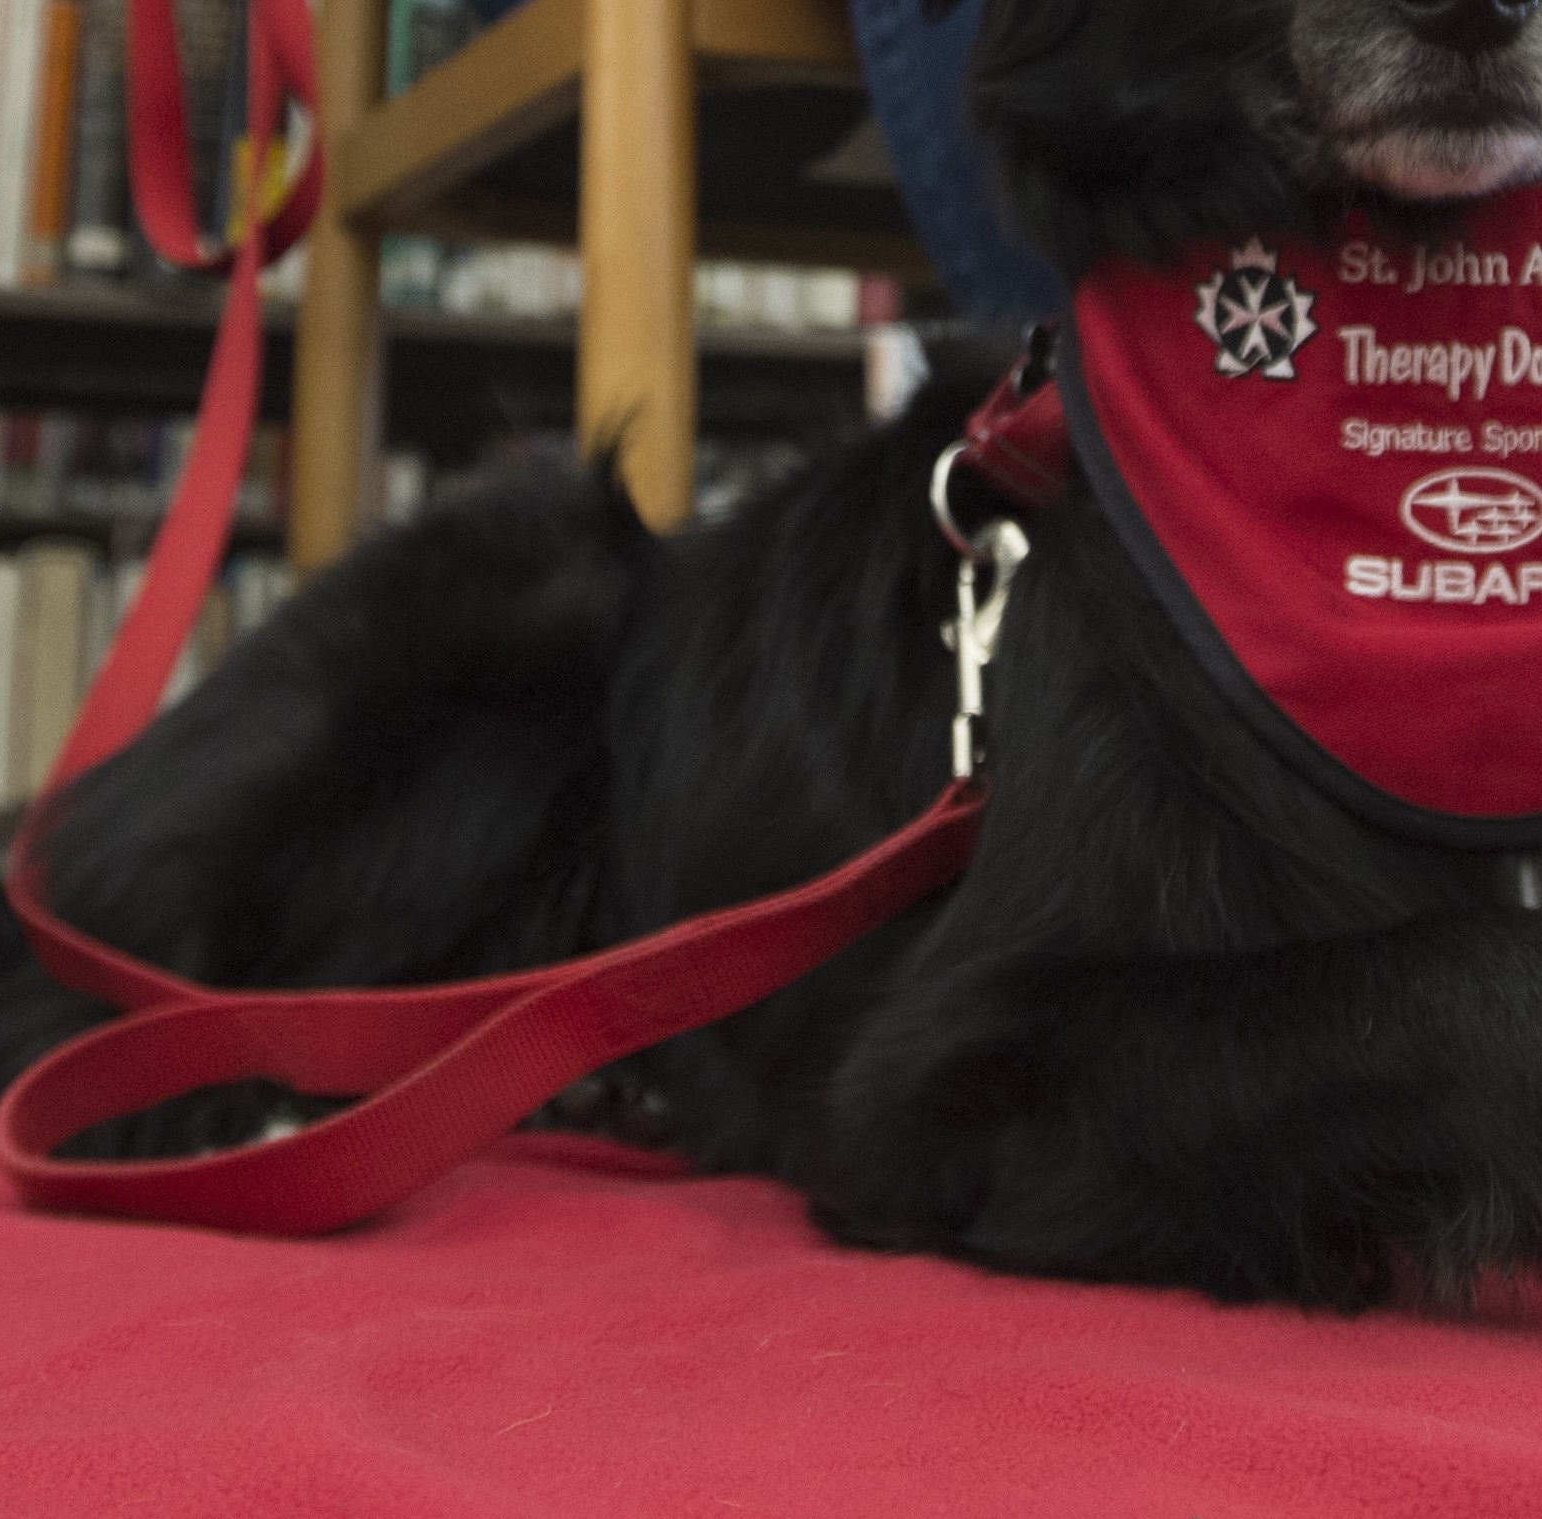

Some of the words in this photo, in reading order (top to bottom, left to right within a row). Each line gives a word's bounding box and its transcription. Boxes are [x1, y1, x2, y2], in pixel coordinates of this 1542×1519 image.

[1340, 241, 1398, 285] St.
[1404, 242, 1510, 294] John
[1339, 326, 1496, 401] Therapy
[1341, 419, 1473, 457] Signature
